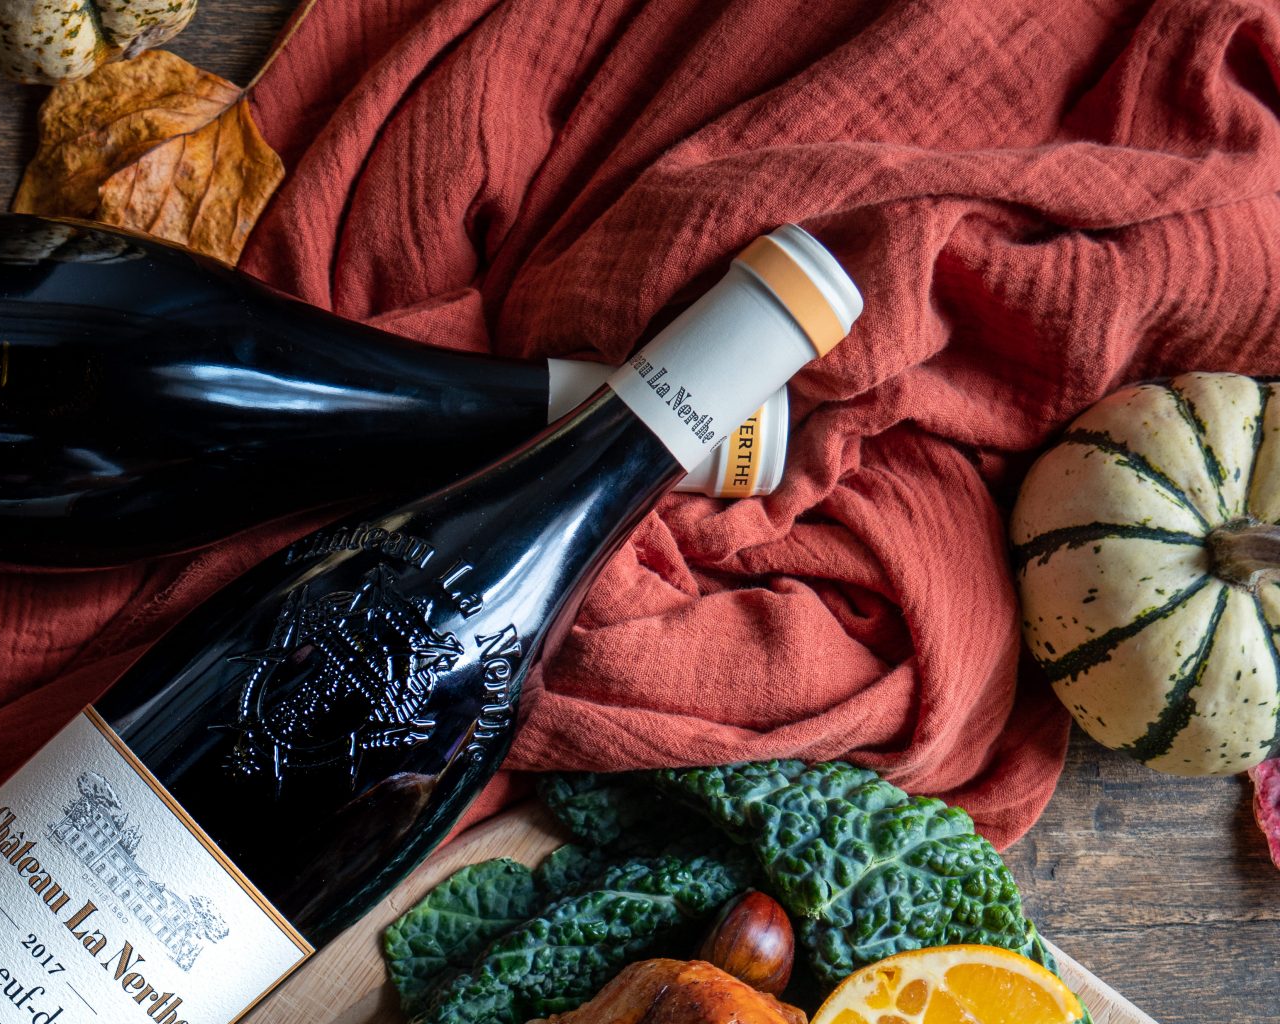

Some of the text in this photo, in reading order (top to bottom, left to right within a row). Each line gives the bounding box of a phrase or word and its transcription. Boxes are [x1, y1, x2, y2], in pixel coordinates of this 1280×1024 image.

[647, 367, 670, 398] La
[666, 386, 715, 444] Nerthe
[21, 934, 66, 975] 2017
[63, 899, 107, 957] La
